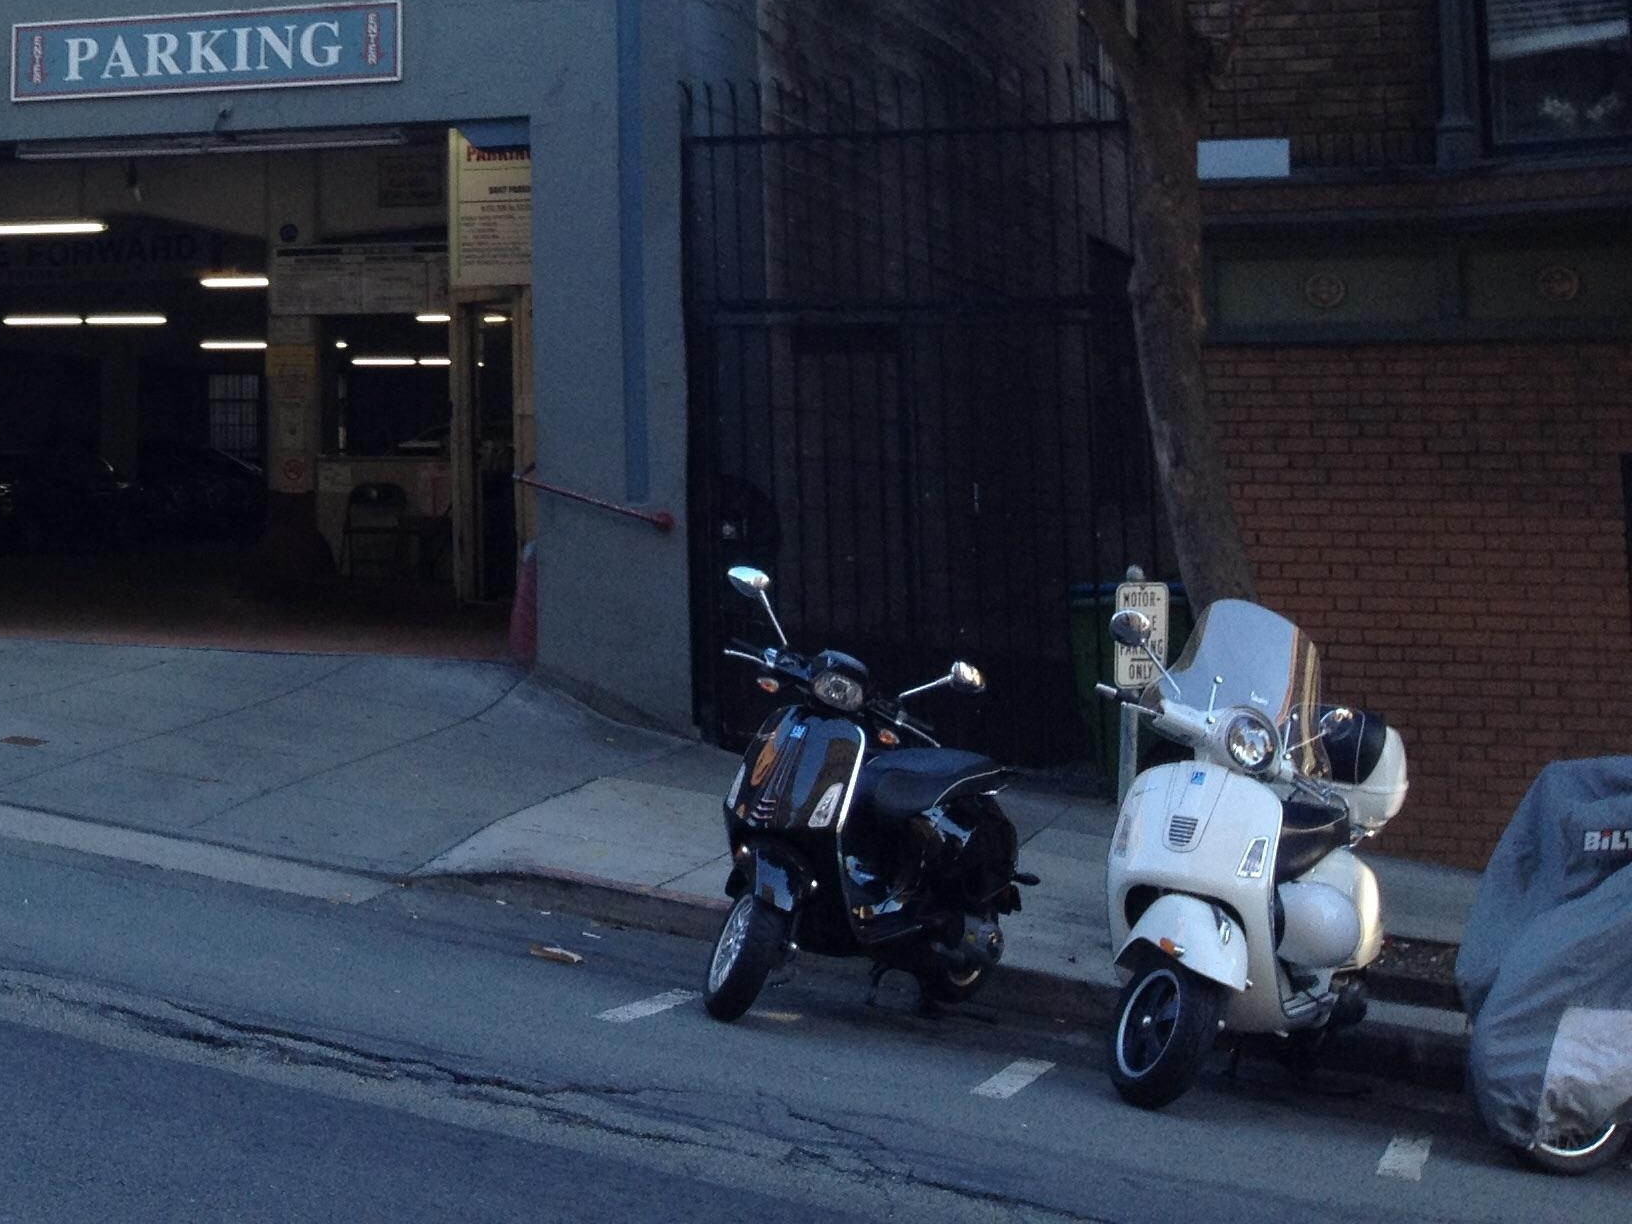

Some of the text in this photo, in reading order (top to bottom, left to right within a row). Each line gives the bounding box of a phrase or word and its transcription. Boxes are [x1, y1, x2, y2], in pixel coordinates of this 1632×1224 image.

[33, 35, 42, 84] ENTER
[64, 20, 343, 82] PARKING
[368, 13, 377, 65] ENTER
[1123, 591, 1161, 608] MOTOR-
[1128, 663, 1154, 680] ONLY
